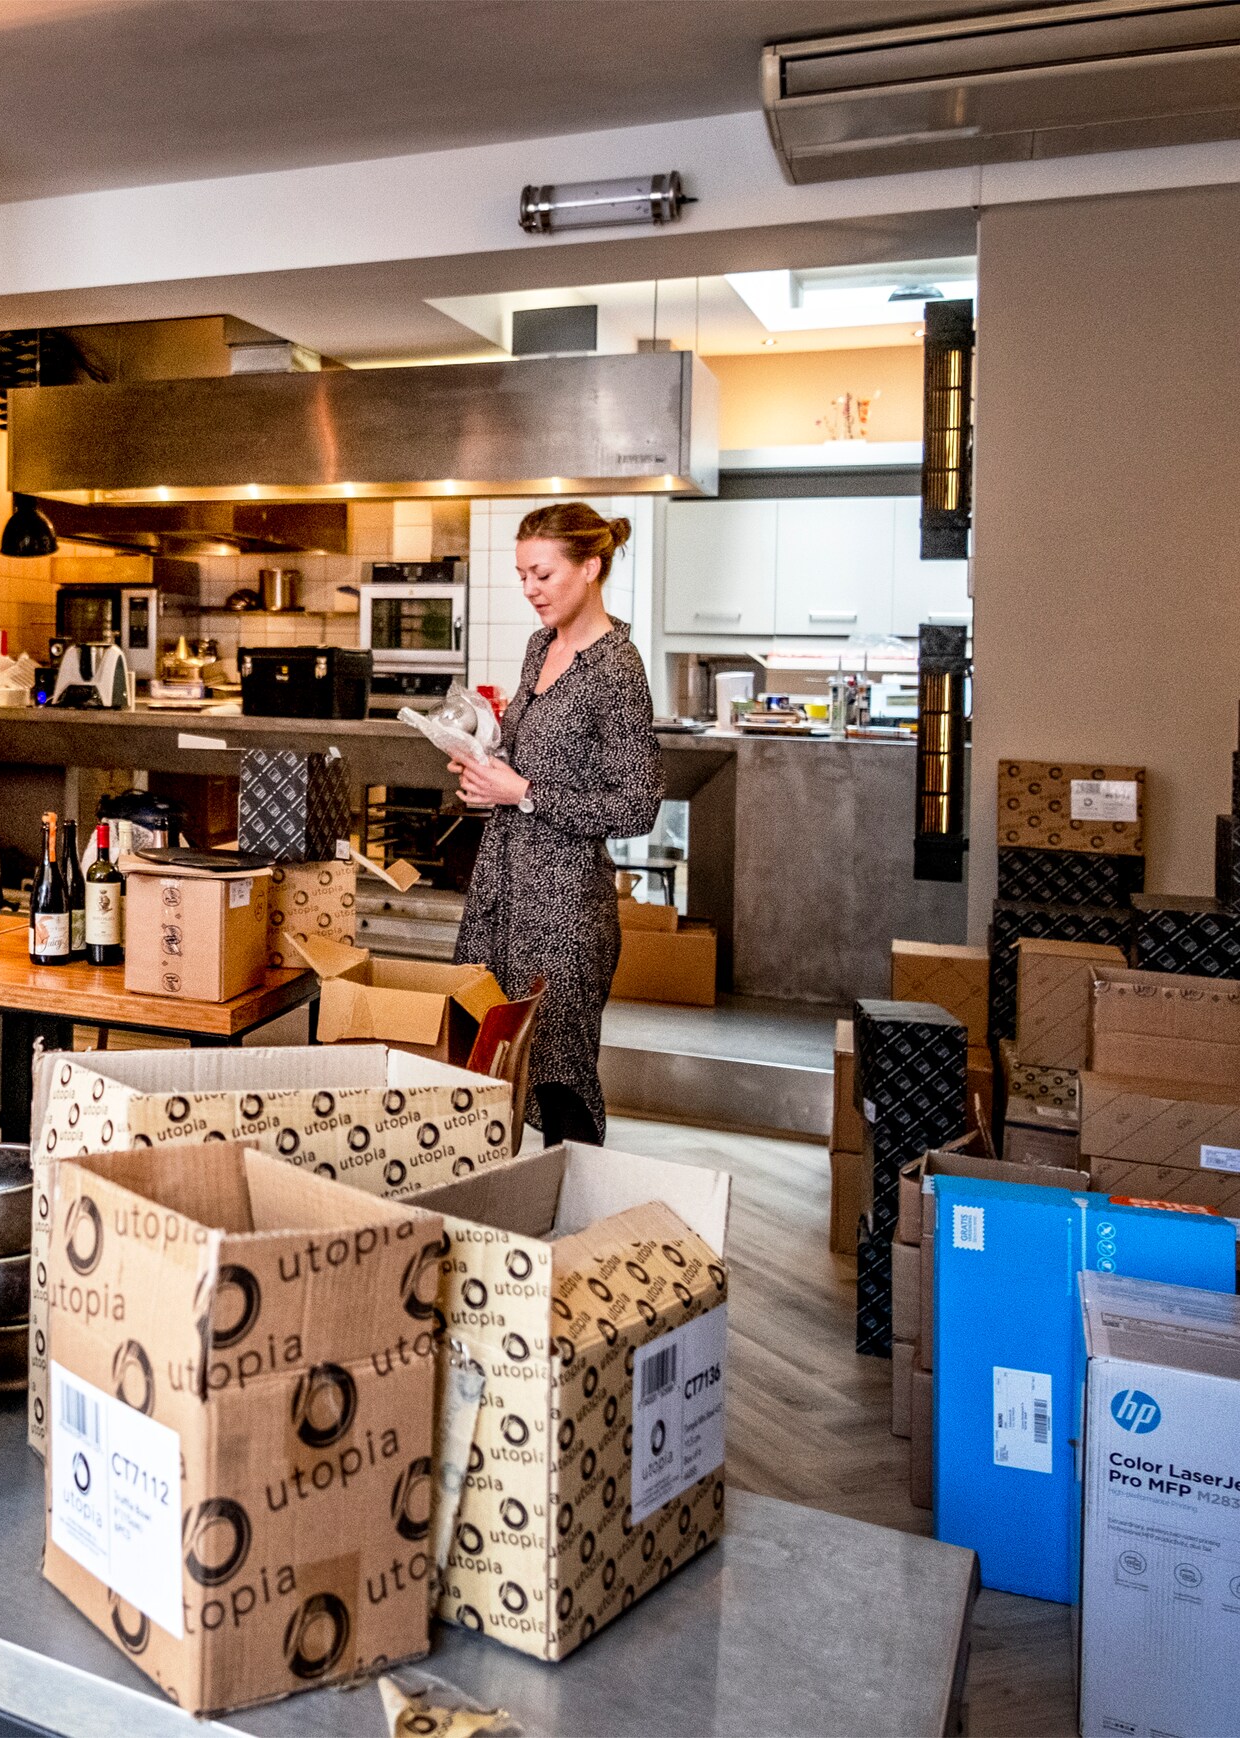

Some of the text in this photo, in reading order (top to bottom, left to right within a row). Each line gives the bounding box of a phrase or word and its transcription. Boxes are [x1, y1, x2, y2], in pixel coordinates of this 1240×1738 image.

[157, 1118, 208, 1142] utopia
[231, 1114, 281, 1139] utopia
[304, 1112, 352, 1137] utopia
[375, 1108, 421, 1133] utopia
[339, 1146, 387, 1172] utopia
[410, 1144, 455, 1169] utopia
[113, 1202, 208, 1256] utopia
[455, 1228, 510, 1245] utopia
[960, 1214, 968, 1241] GRATIS
[278, 1220, 414, 1283] utopia
[451, 1310, 506, 1327] utopia
[168, 1332, 303, 1393] utopia
[684, 1362, 721, 1400] CT7136
[1114, 1389, 1159, 1434] hp
[264, 1427, 400, 1513] utopia
[1109, 1452, 1163, 1474] Color
[112, 1452, 170, 1506] CT7112
[1109, 1469, 1142, 1488] Pro
[1148, 1477, 1192, 1497] MFP
[63, 1487, 103, 1529] utopia
[182, 1565, 298, 1635] topia
